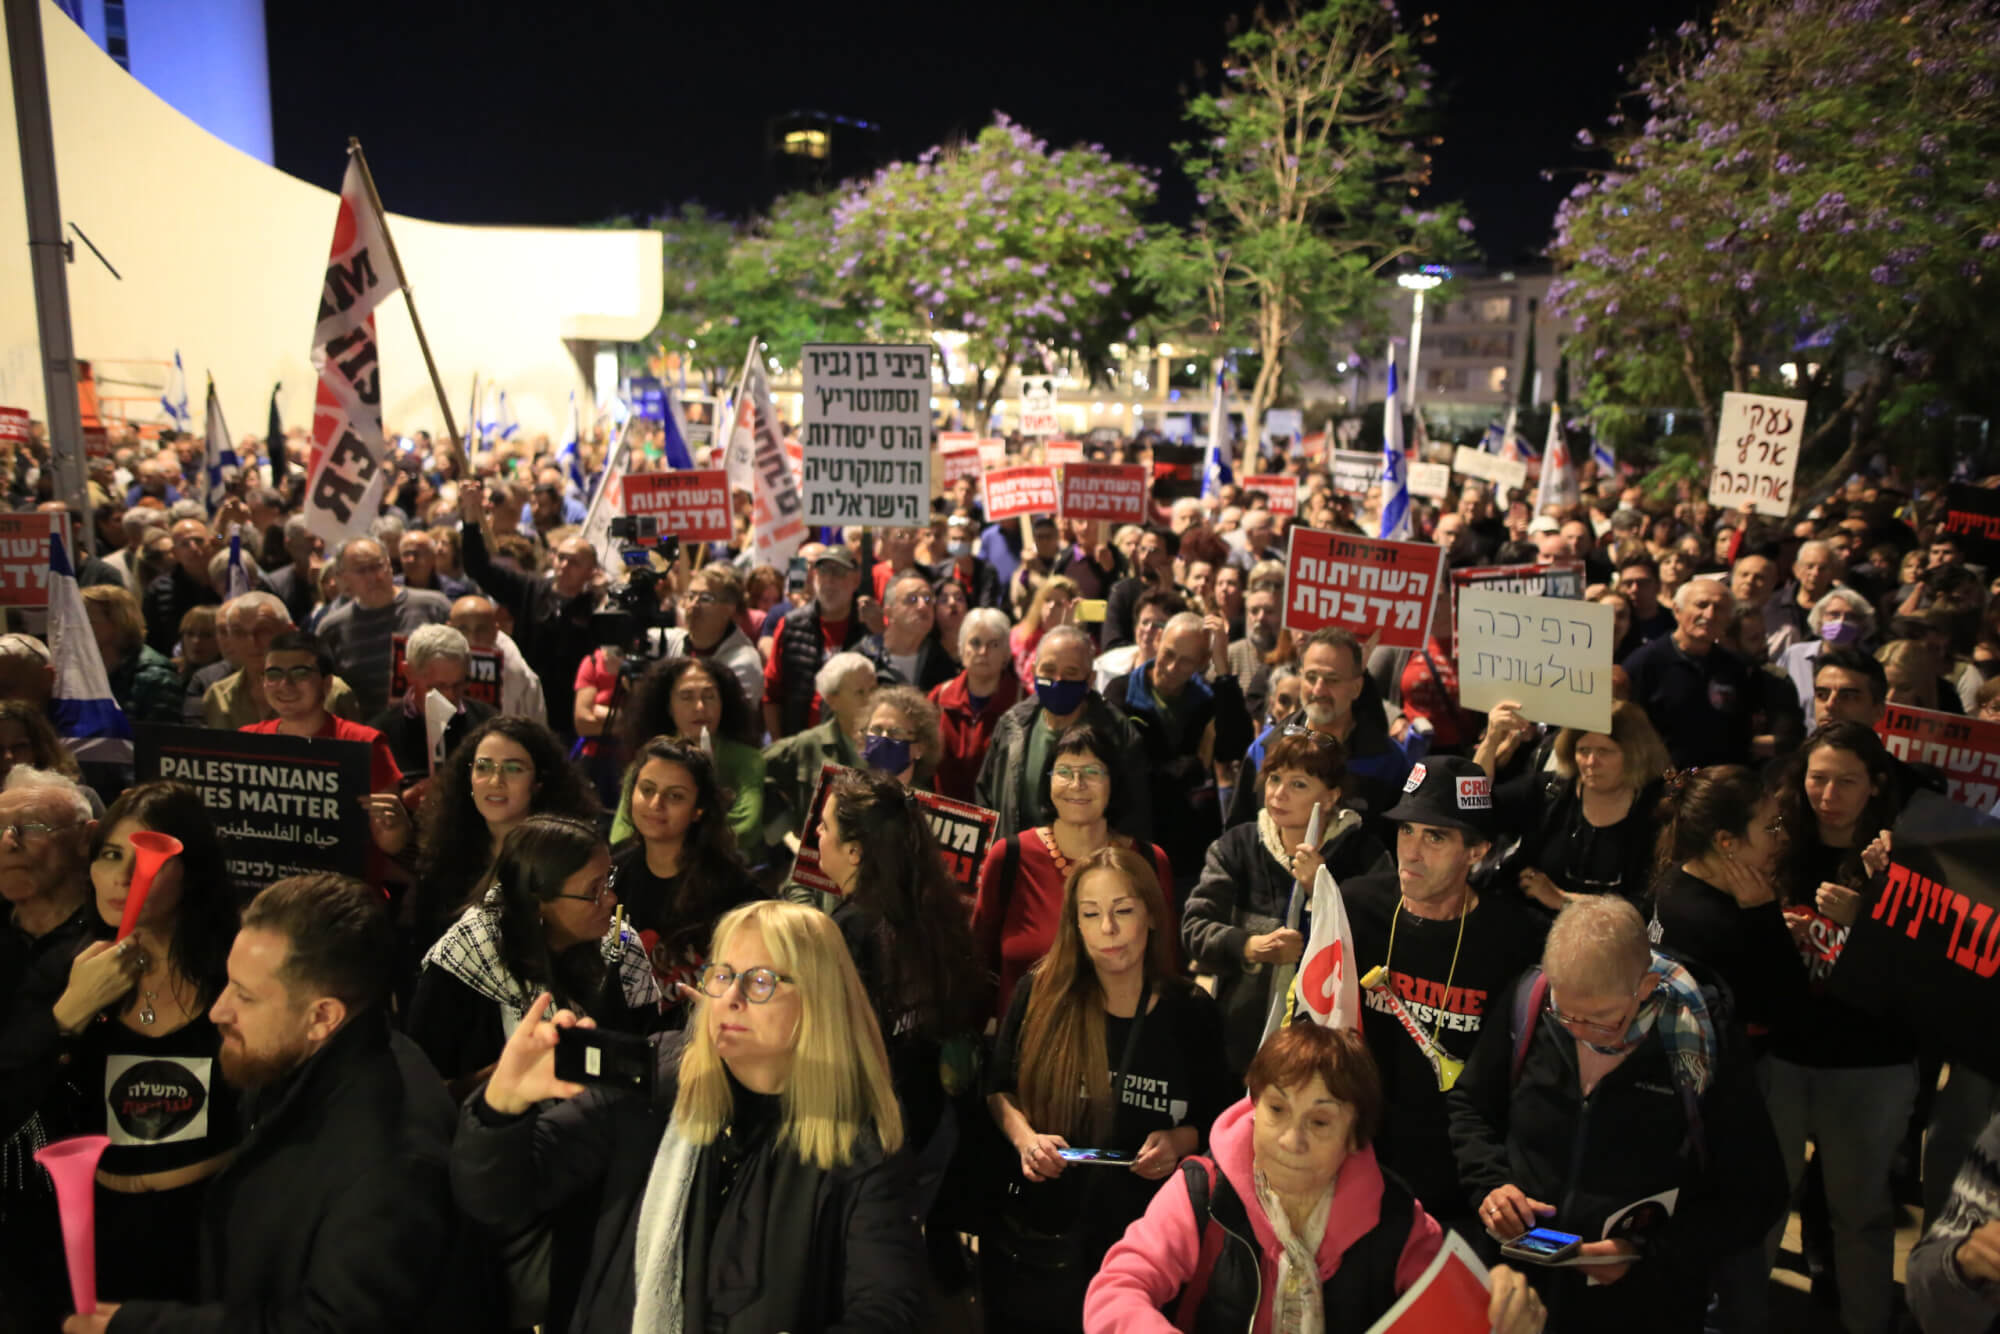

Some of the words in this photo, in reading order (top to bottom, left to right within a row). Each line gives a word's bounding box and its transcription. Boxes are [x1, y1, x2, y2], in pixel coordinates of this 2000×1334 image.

[808, 351, 852, 377] גביר
[856, 351, 878, 381] בן
[883, 353, 927, 379] ביבי
[806, 422, 875, 449] יסודות
[880, 425, 922, 449] הרס
[805, 456, 922, 488] הדמוקרטיה
[1068, 476, 1141, 493] השחיתות
[631, 488, 724, 511] השחיתות
[810, 489, 918, 518] הישראלית
[991, 490, 1054, 511] מדבקת
[1066, 493, 1140, 513] מדבקת
[657, 508, 726, 534] מדבק
[1328, 538, 1399, 563] זהירות!
[1297, 556, 1429, 596] השחיתות
[1293, 584, 1423, 630] מדבקת
[1473, 608, 1592, 648] הפיכה
[1472, 652, 1593, 694] שלטונית
[160, 757, 340, 793] PALESTINIANS
[239, 789, 340, 820] MATTER
[1390, 970, 1488, 1015] RIME
[128, 1081, 189, 1099] ממשלה
